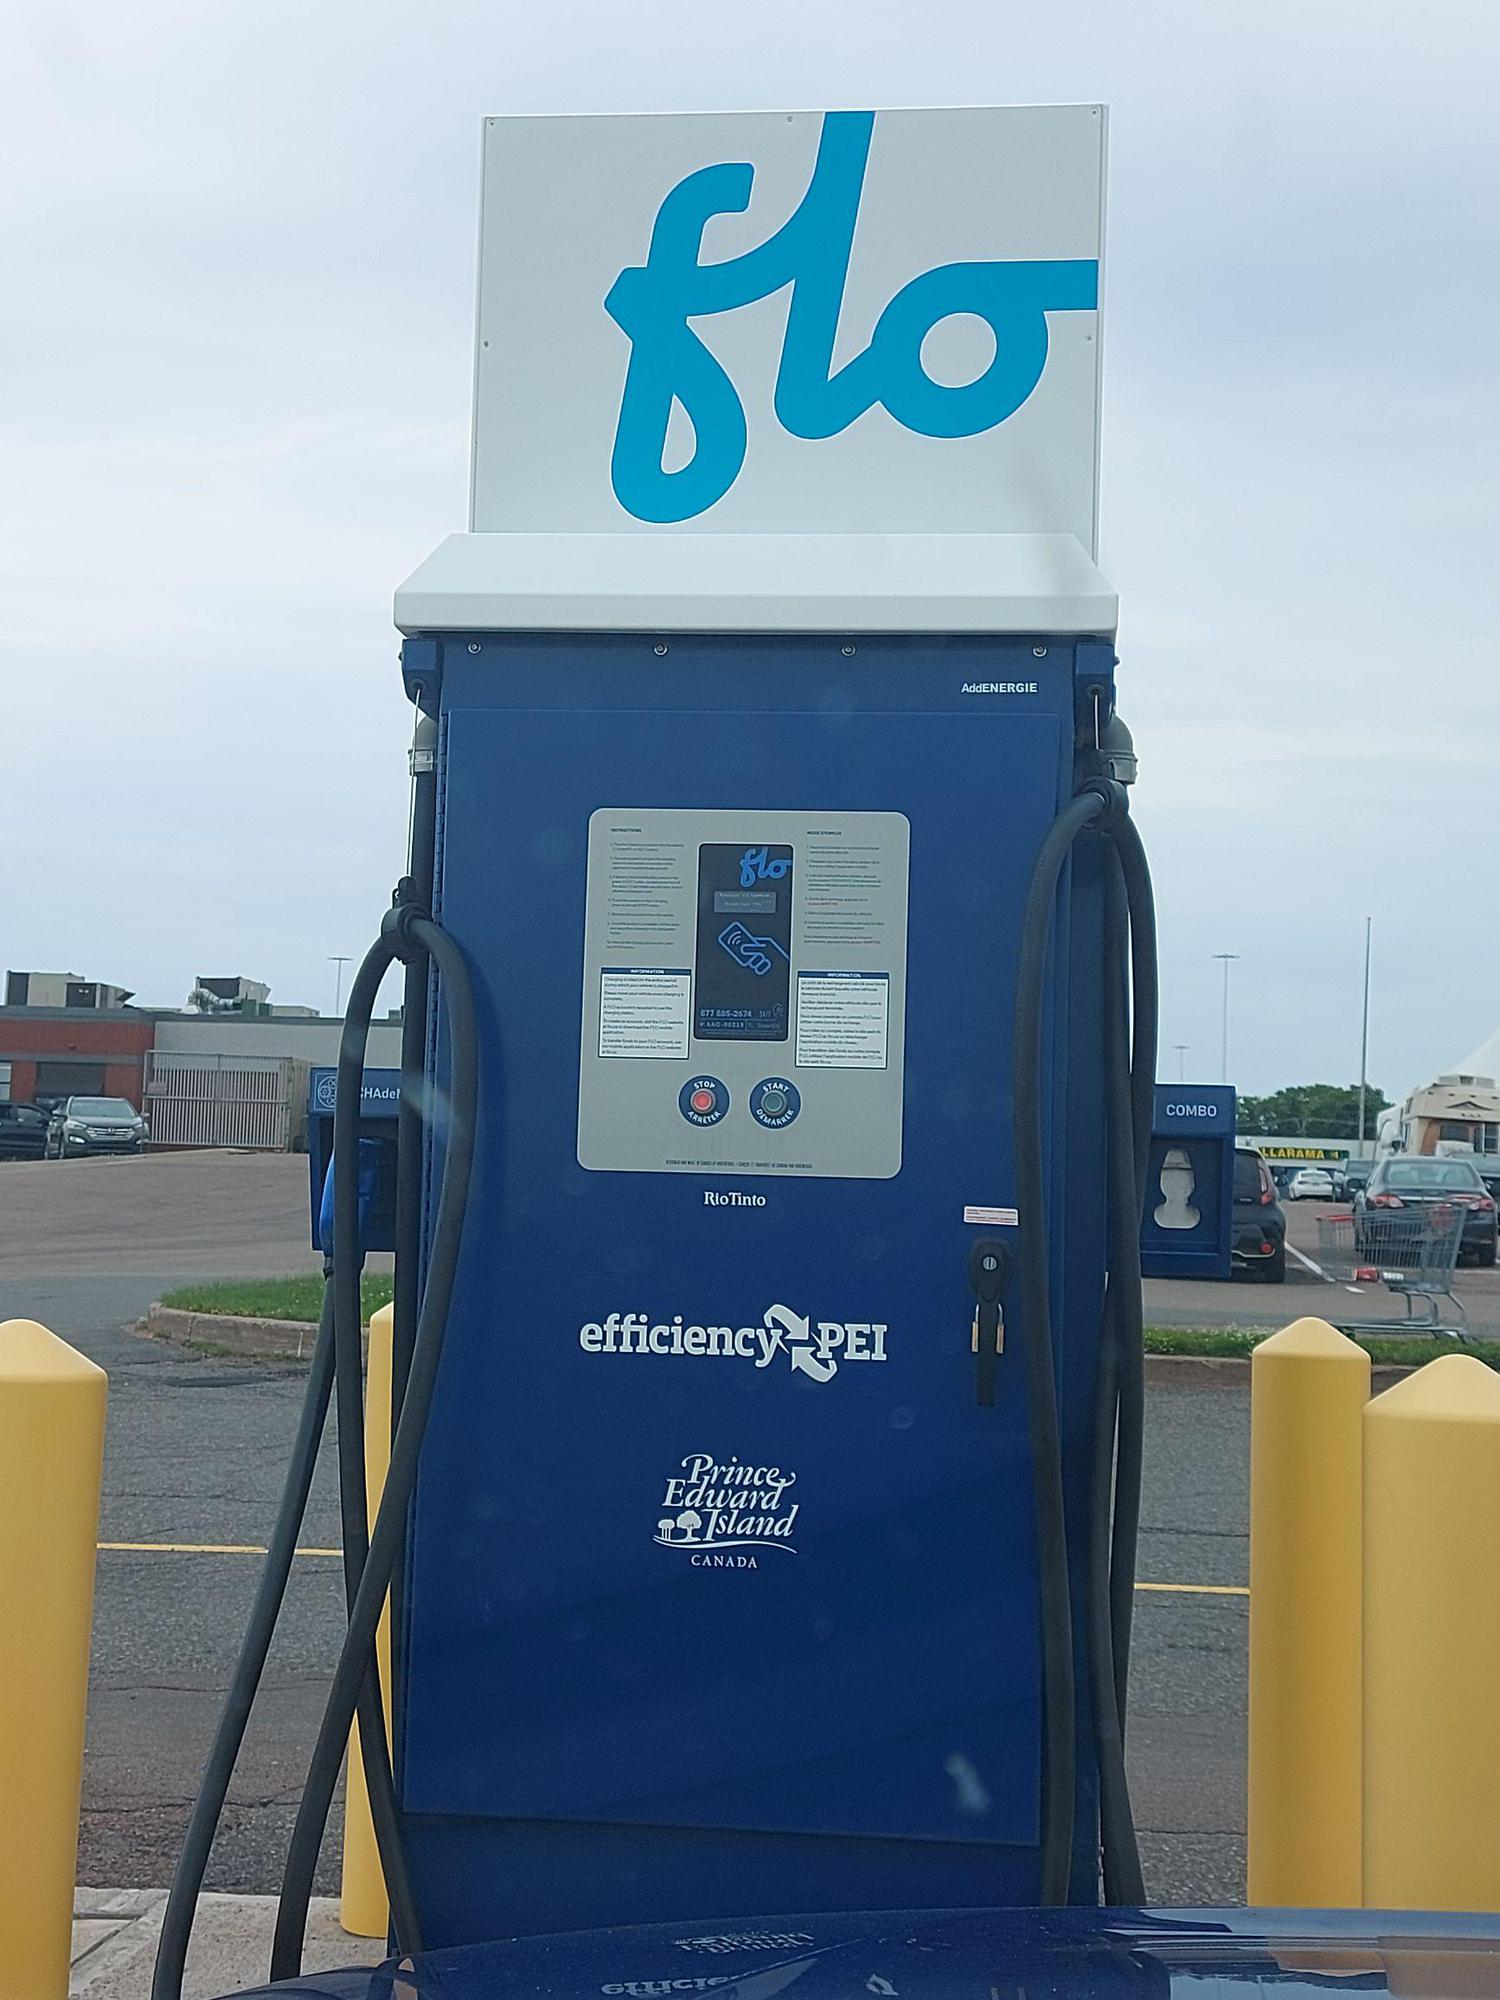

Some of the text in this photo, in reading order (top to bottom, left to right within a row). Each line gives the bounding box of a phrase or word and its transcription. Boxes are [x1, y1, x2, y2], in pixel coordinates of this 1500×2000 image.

[603, 111, 1099, 525] flo
[961, 682, 1038, 693] AddENERGIE
[740, 846, 793, 888] flo
[693, 1080, 716, 1090] STOP
[762, 1082, 790, 1092] START
[361, 1086, 401, 1100] HAde
[1166, 1103, 1218, 1118] COMBO
[1261, 1147, 1325, 1160] LLARAMA
[579, 1312, 888, 1368] efficiency PEI
[681, 1453, 797, 1488] Prince
[661, 1475, 787, 1510] Edward
[700, 1504, 800, 1542] Island
[690, 1554, 758, 1569] CANADA
